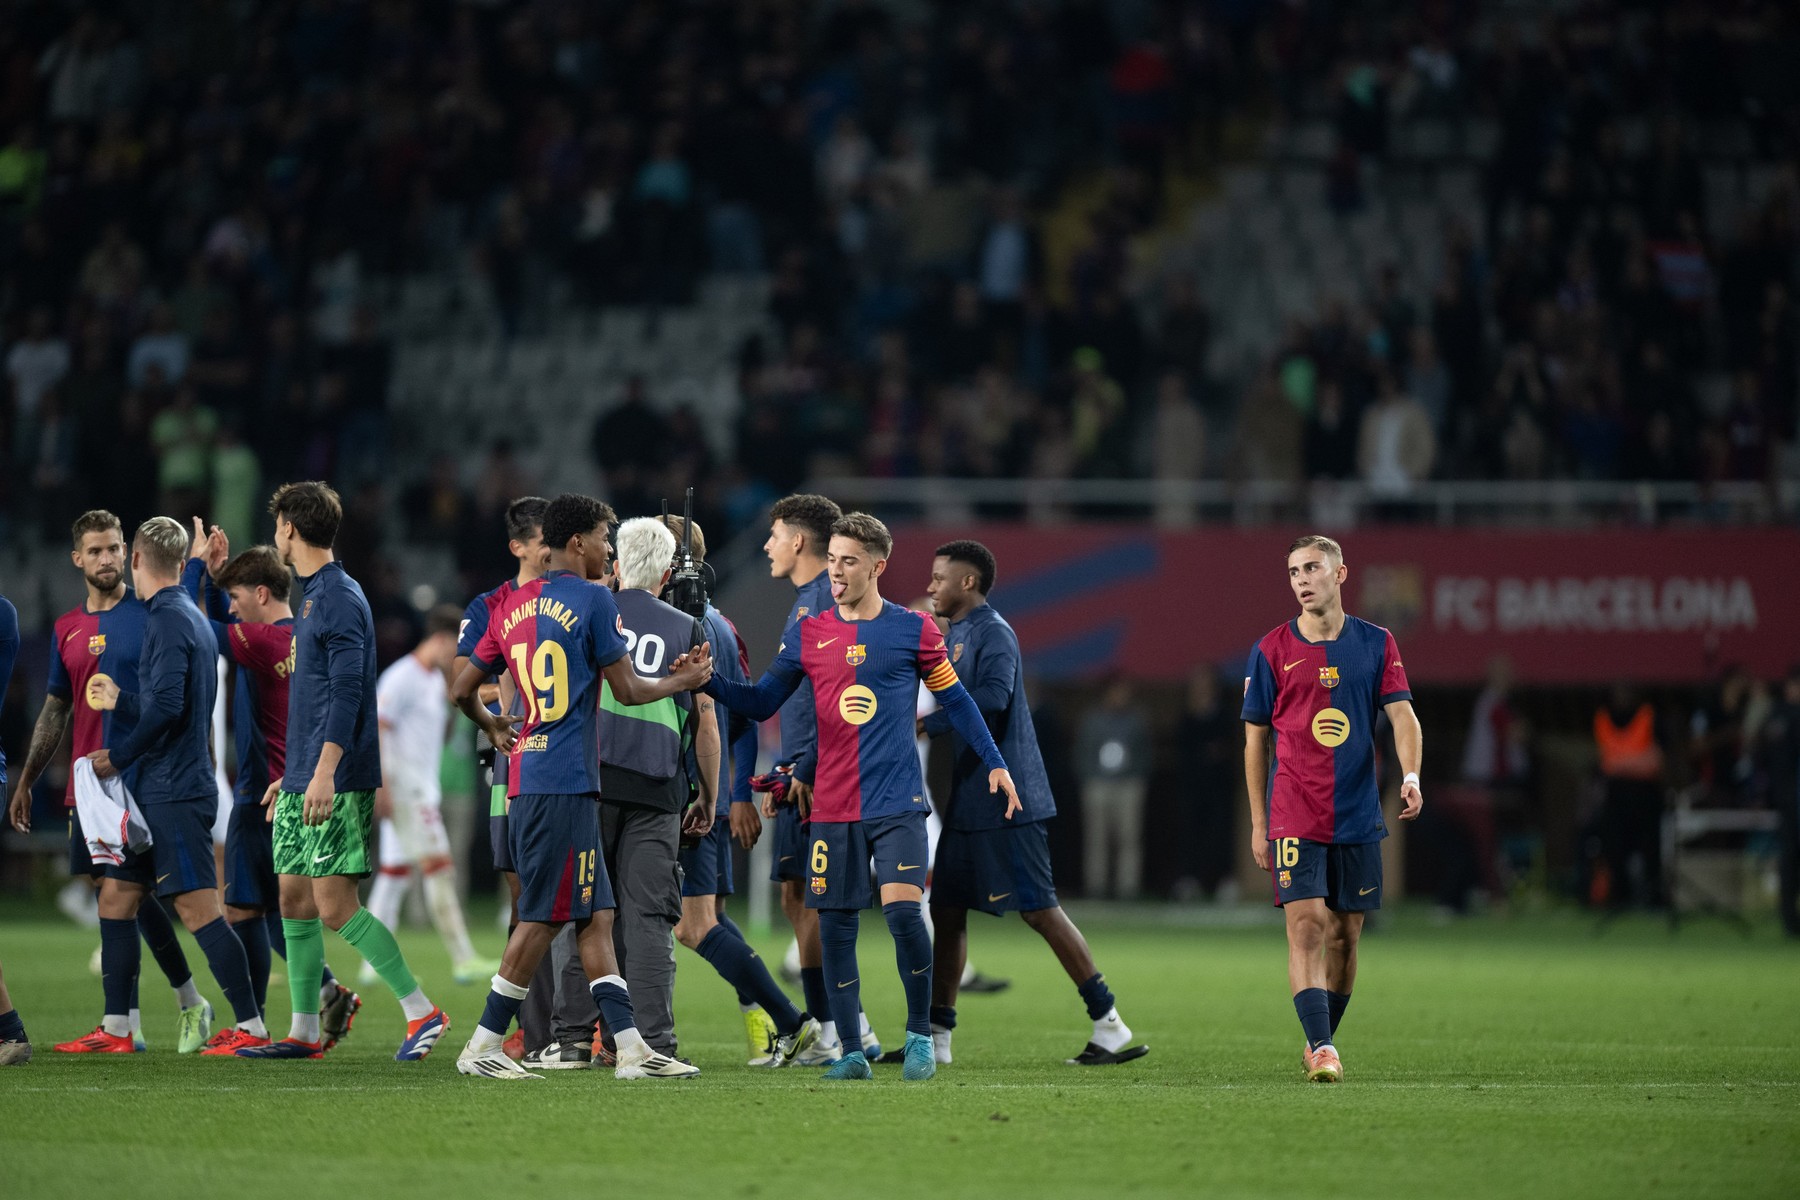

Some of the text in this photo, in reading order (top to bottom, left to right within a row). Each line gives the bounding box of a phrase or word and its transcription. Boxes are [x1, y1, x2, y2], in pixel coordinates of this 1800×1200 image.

[500, 597, 578, 640] LAMINE YAMAL
[1433, 577, 1757, 631] FC BARCELONA
[510, 639, 569, 724] 19
[578, 848, 596, 885] 19
[811, 839, 829, 874] 6
[1275, 837, 1300, 869] 16
